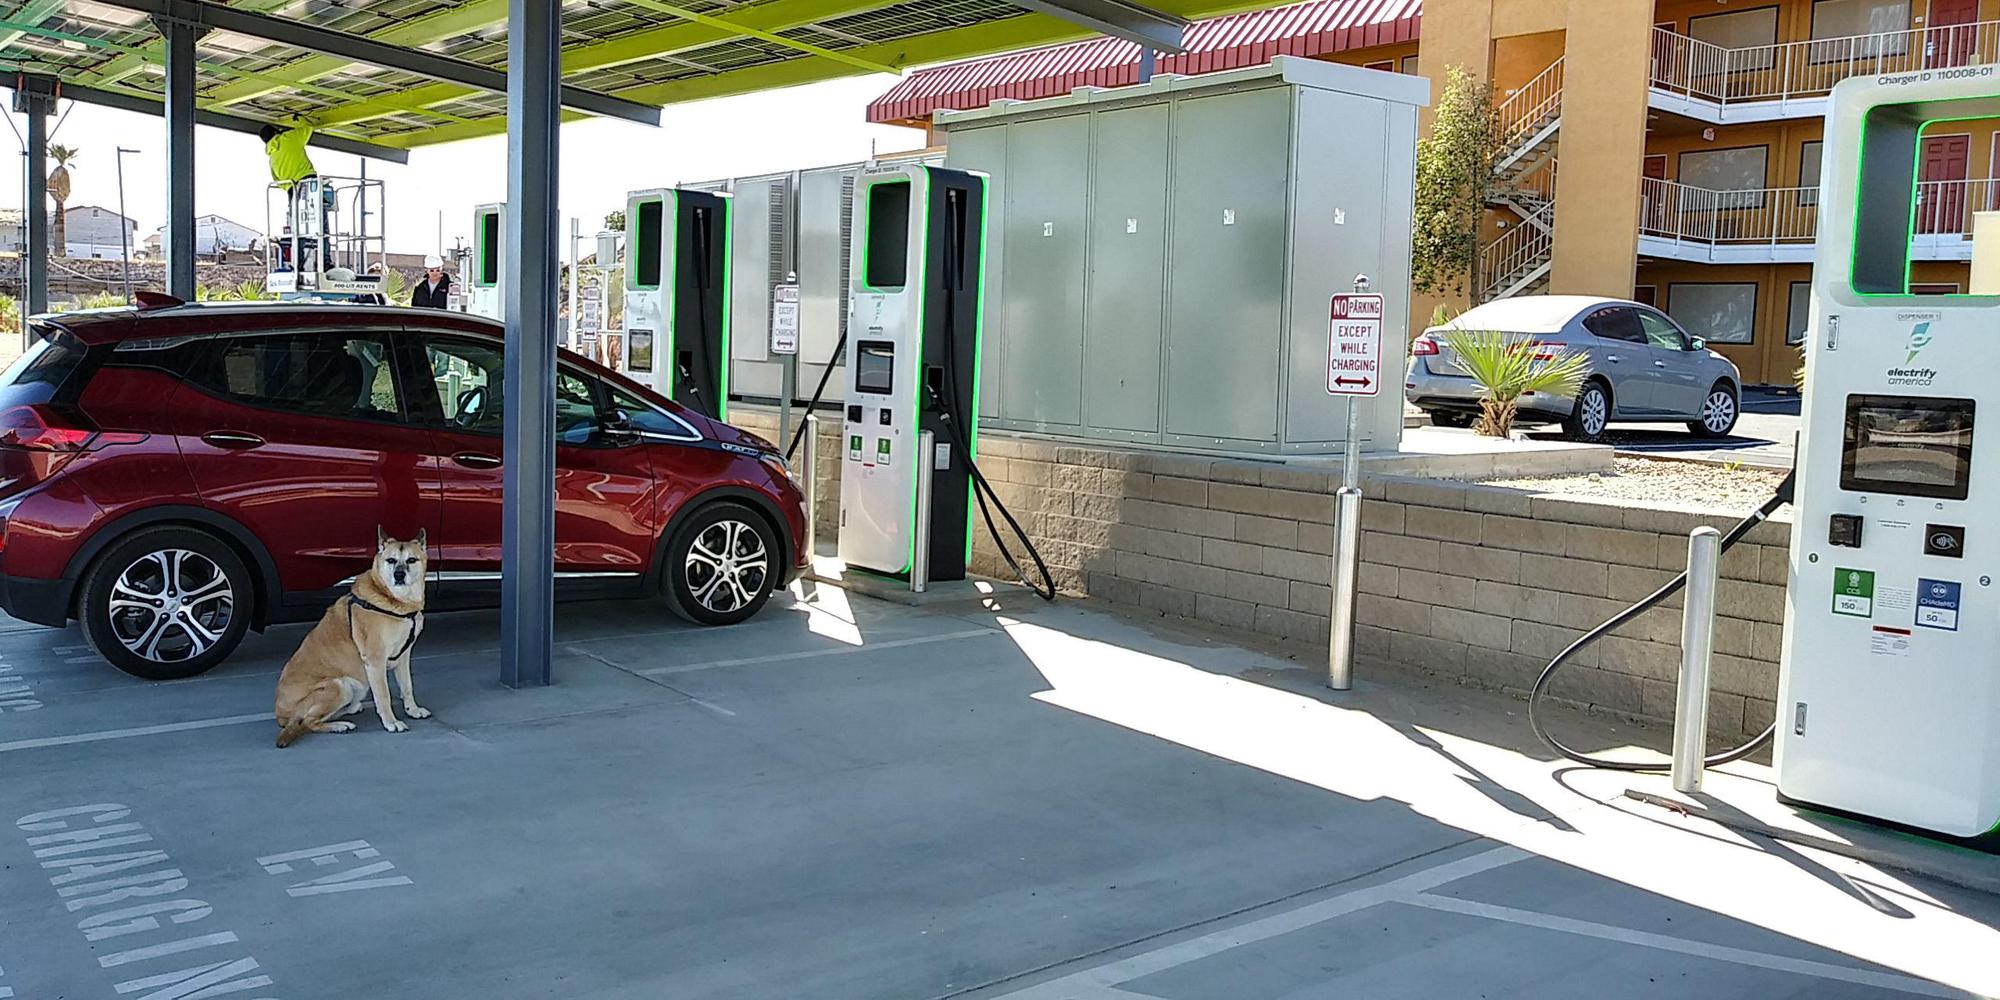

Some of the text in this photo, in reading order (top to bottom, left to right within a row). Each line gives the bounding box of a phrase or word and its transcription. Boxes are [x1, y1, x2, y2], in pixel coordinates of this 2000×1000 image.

[1878, 67, 1993, 85] Charger ID 110008-01
[1333, 299, 1380, 316] NO PARKING
[1338, 325, 1372, 338] EXCEPT
[1340, 342, 1368, 354] WHILE
[1331, 358, 1376, 372] CHARGING
[1887, 368, 1937, 379] electrify
[1887, 377, 1932, 386] america
[1846, 587, 1861, 595] CCS
[1841, 602, 1856, 610] 150
[1920, 598, 1956, 608] CHAdeMO
[1926, 614, 1938, 622] 50
[255, 839, 416, 898] EV
[16, 802, 286, 1000] CHARGIN
